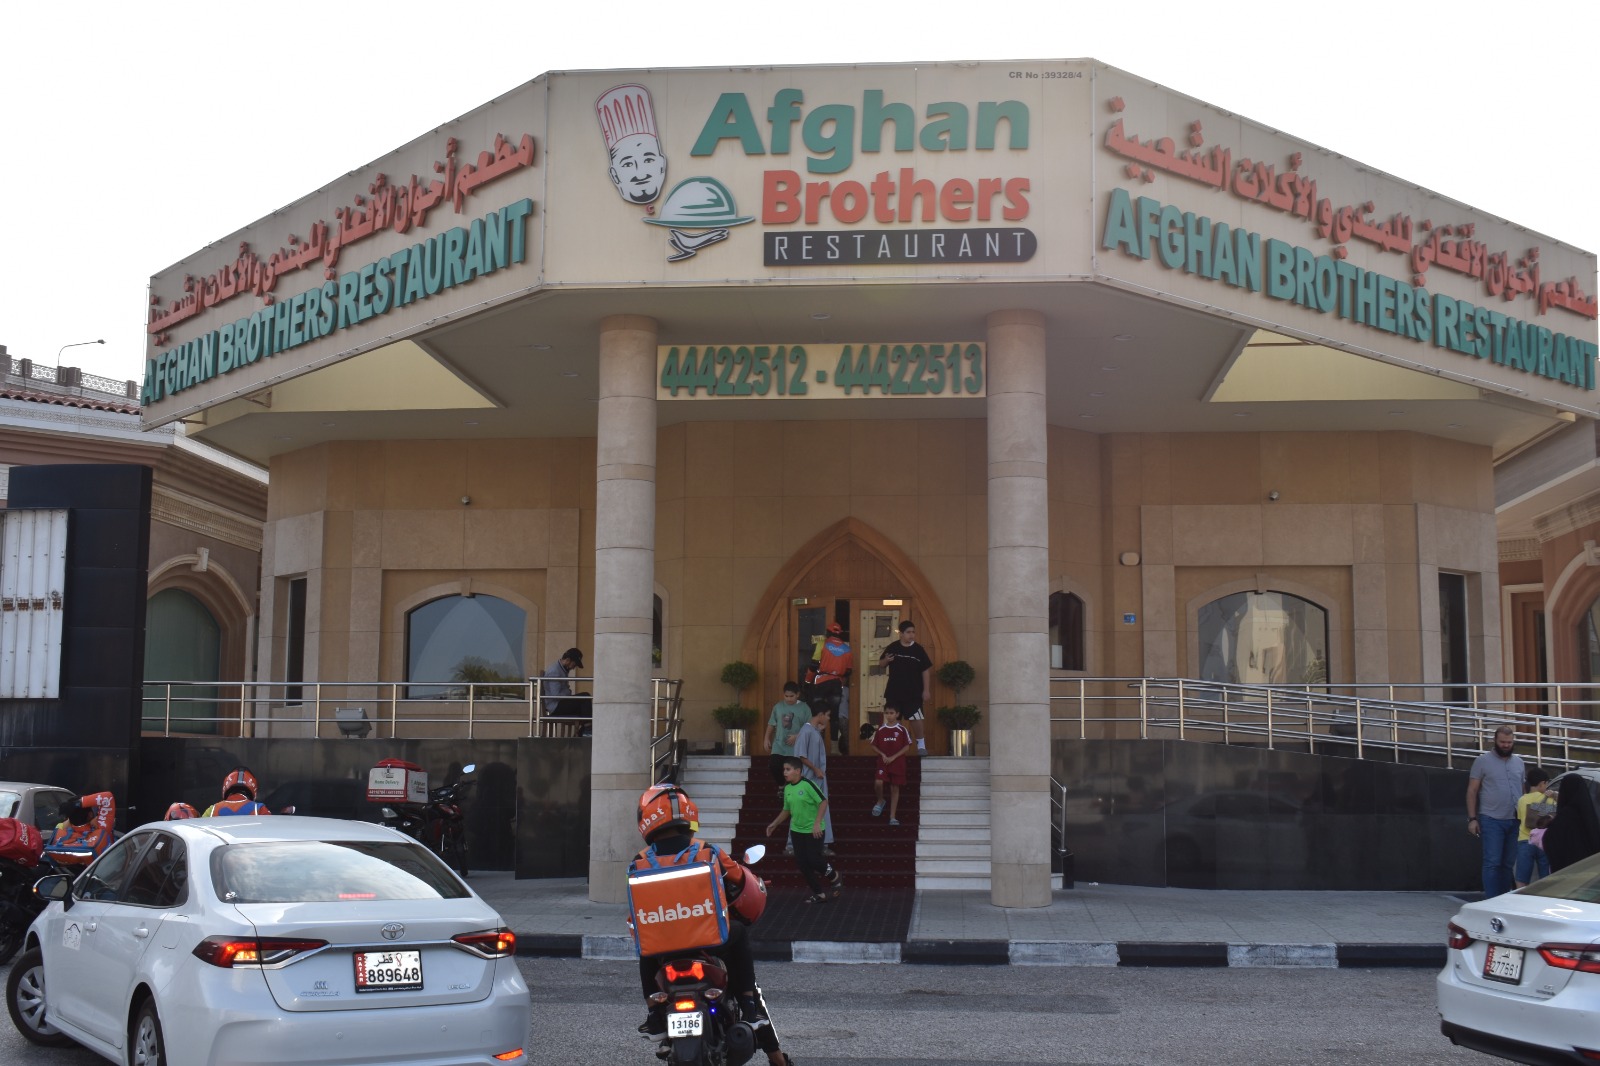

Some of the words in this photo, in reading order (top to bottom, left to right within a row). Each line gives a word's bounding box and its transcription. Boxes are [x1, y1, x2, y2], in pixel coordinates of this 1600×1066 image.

[1009, 71, 1022, 79] CR
[1025, 71, 1039, 79] No
[690, 88, 1030, 174] Afghan
[1104, 95, 1232, 192] الشعبية
[453, 133, 535, 214] مطعم
[762, 168, 1030, 225] Brothers
[774, 231, 1027, 261] RESTAURANT
[141, 330, 218, 406] AFGHAN
[217, 280, 338, 375] BROTHERS
[338, 198, 534, 330] RESTAURANT
[1103, 187, 1261, 293] AFGHAN
[1266, 237, 1433, 343] BROTHERS
[1433, 293, 1599, 391] RESTAURANT
[661, 345, 808, 397] 44422512
[834, 343, 983, 396] 44422513
[636, 898, 714, 925] talabat
[368, 966, 420, 983] 889648
[373, 953, 394, 967] قطر
[671, 1019, 700, 1030] 13186
